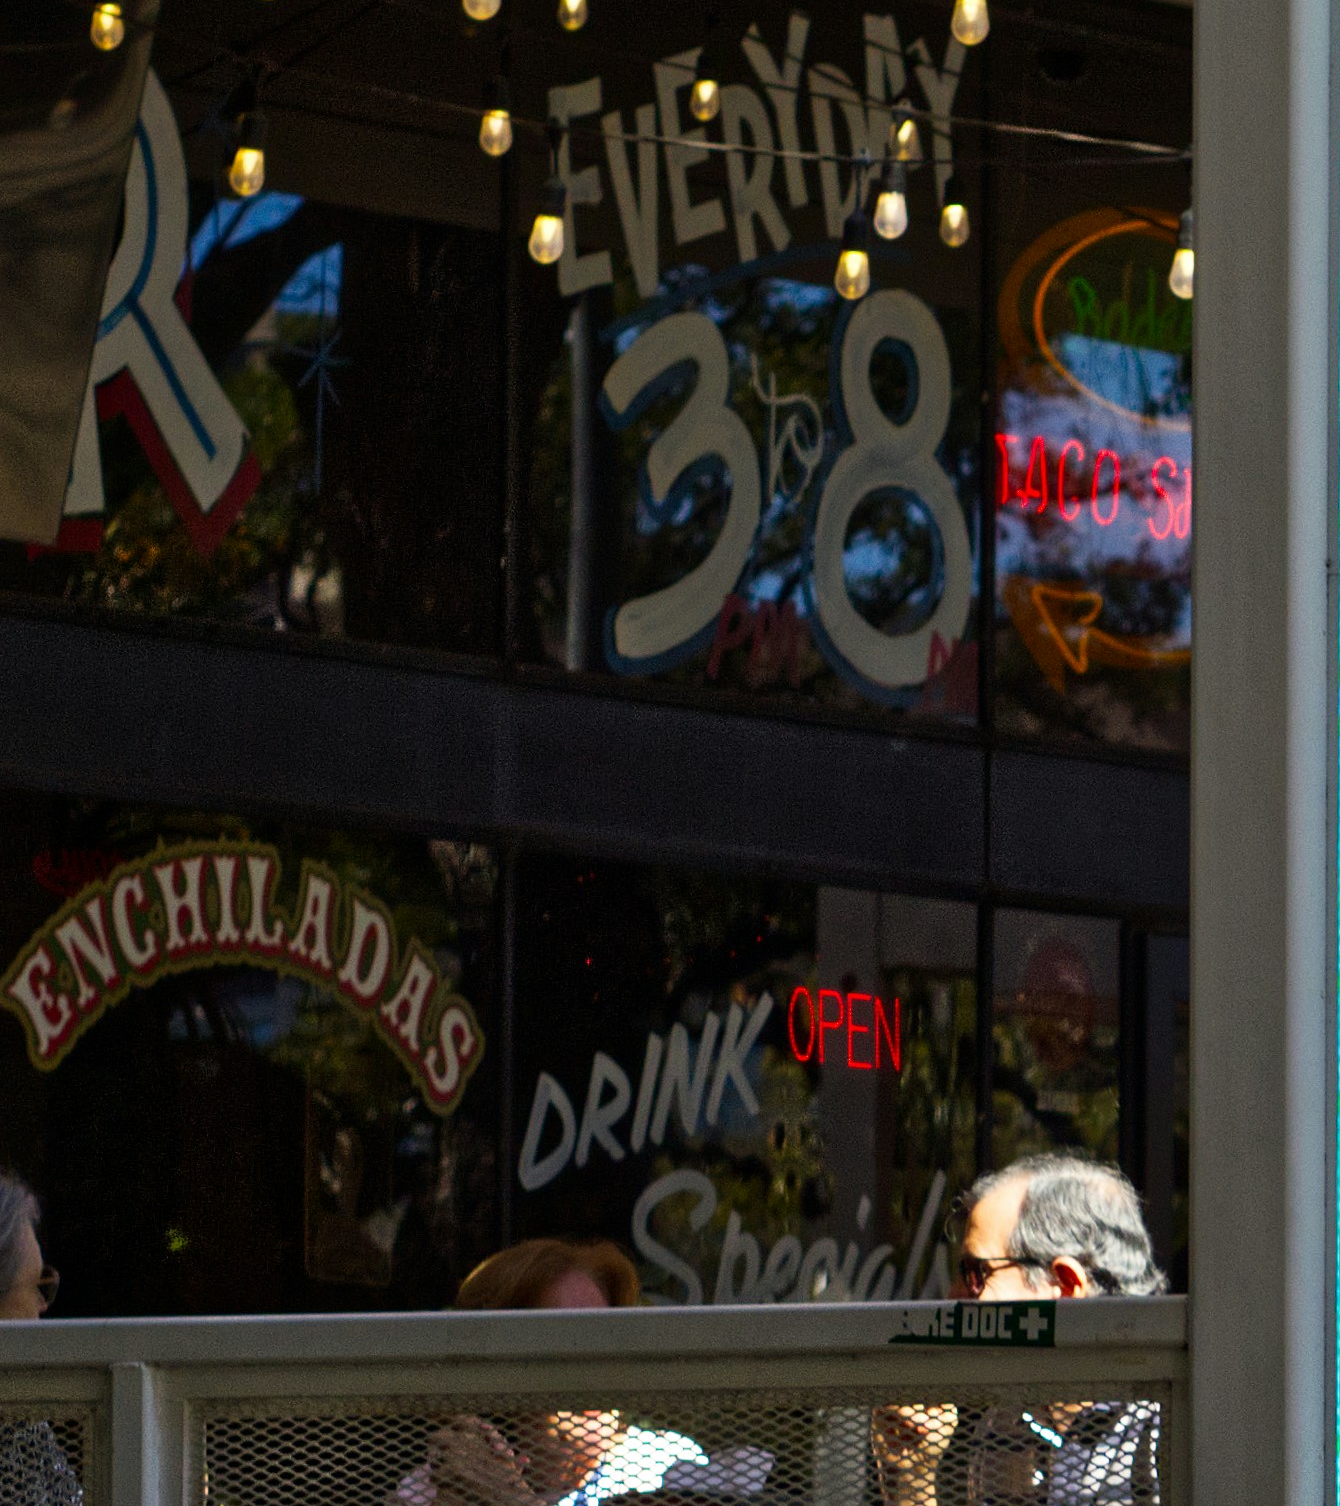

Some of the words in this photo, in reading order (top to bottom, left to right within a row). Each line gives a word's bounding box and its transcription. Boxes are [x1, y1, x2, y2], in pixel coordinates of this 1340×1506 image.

[548, 10, 970, 296] EVERYDAY
[603, 308, 762, 670] 3
[813, 288, 974, 691] 8
[994, 434, 1121, 526] TACO
[6, 854, 480, 1100] ENCHILADAS
[787, 985, 902, 1072] OPEN
[517, 991, 776, 1192] DRINK
[961, 1305, 1013, 1339] DOC
